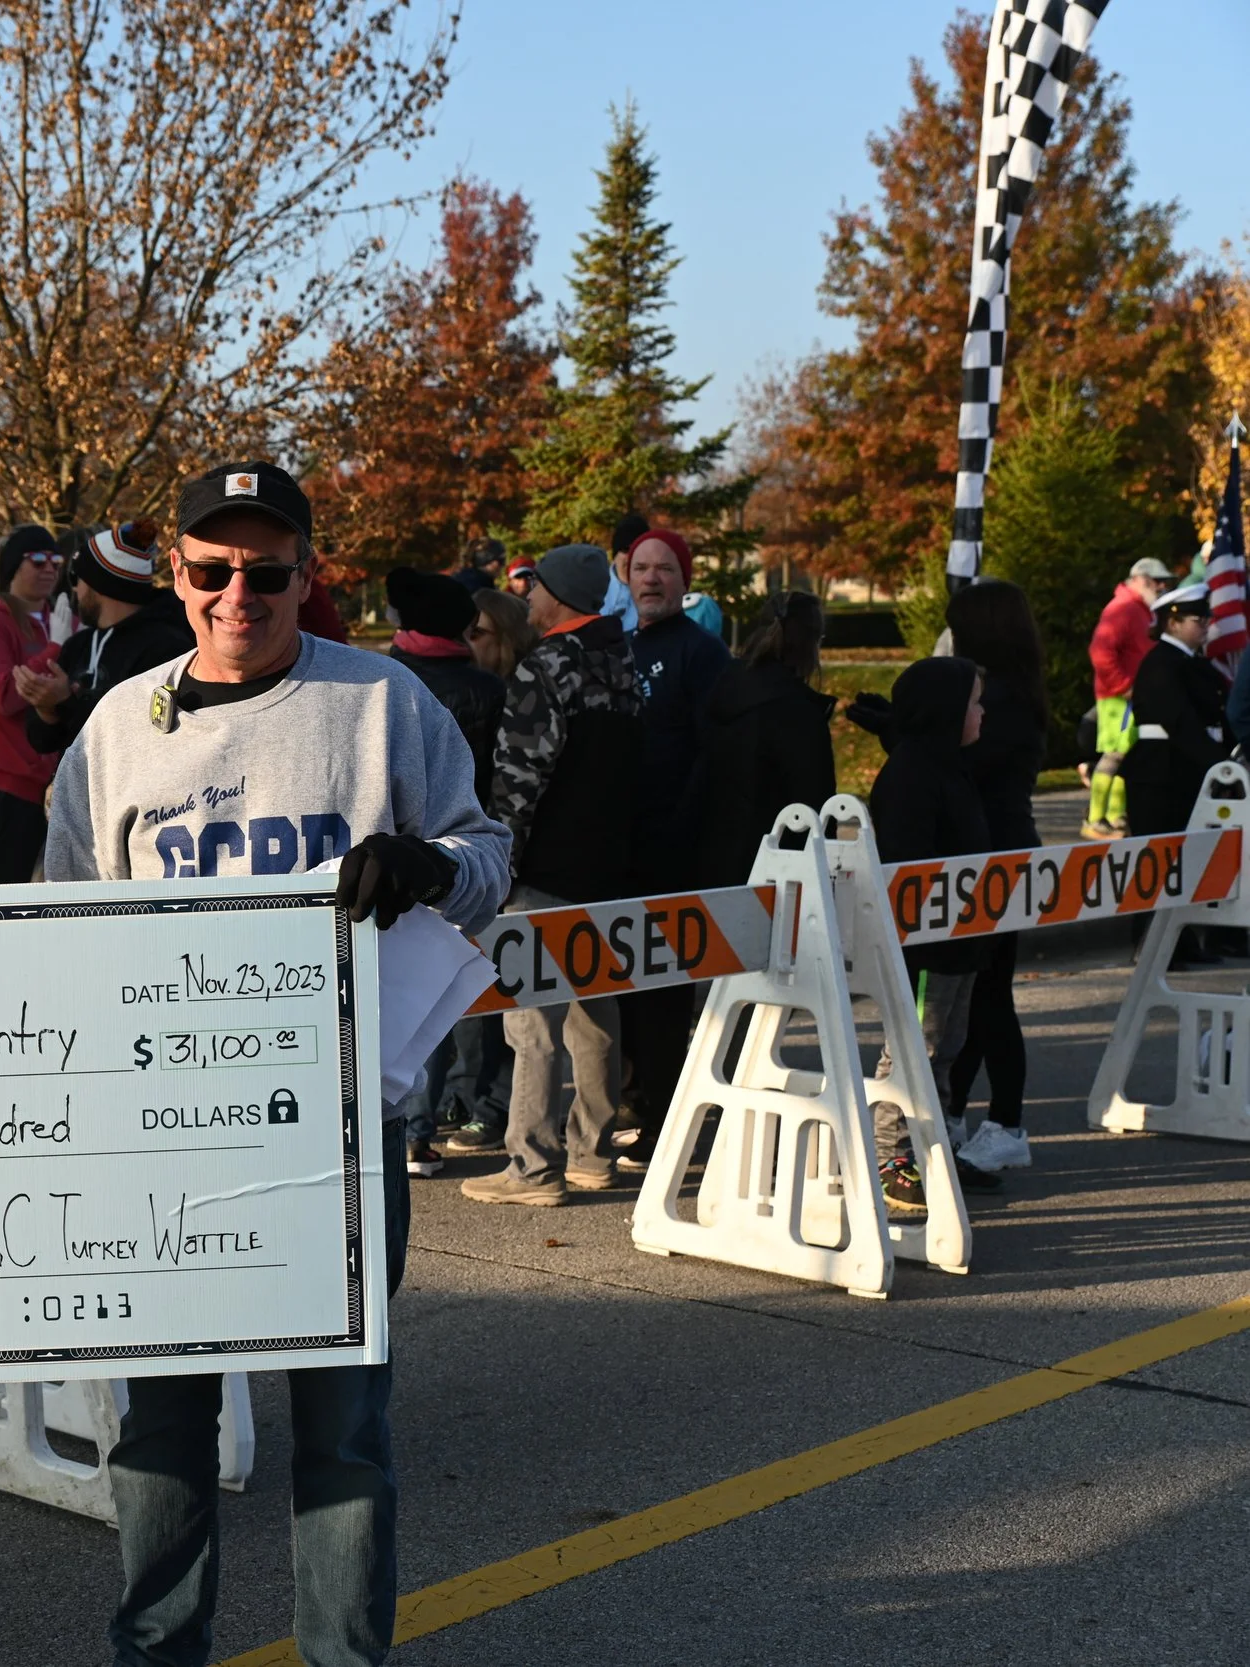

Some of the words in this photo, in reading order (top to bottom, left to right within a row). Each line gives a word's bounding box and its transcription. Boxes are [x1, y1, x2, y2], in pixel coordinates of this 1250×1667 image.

[144, 793, 197, 825] Thank
[202, 775, 246, 806] You!
[896, 859, 1060, 933] CLOSED
[1082, 844, 1183, 908] ROAD
[491, 906, 708, 998] CLOSED
[121, 983, 180, 1005] DATE
[178, 954, 231, 998] Nov.
[133, 1033, 154, 1071] $
[142, 1104, 262, 1131] DOLLARS
